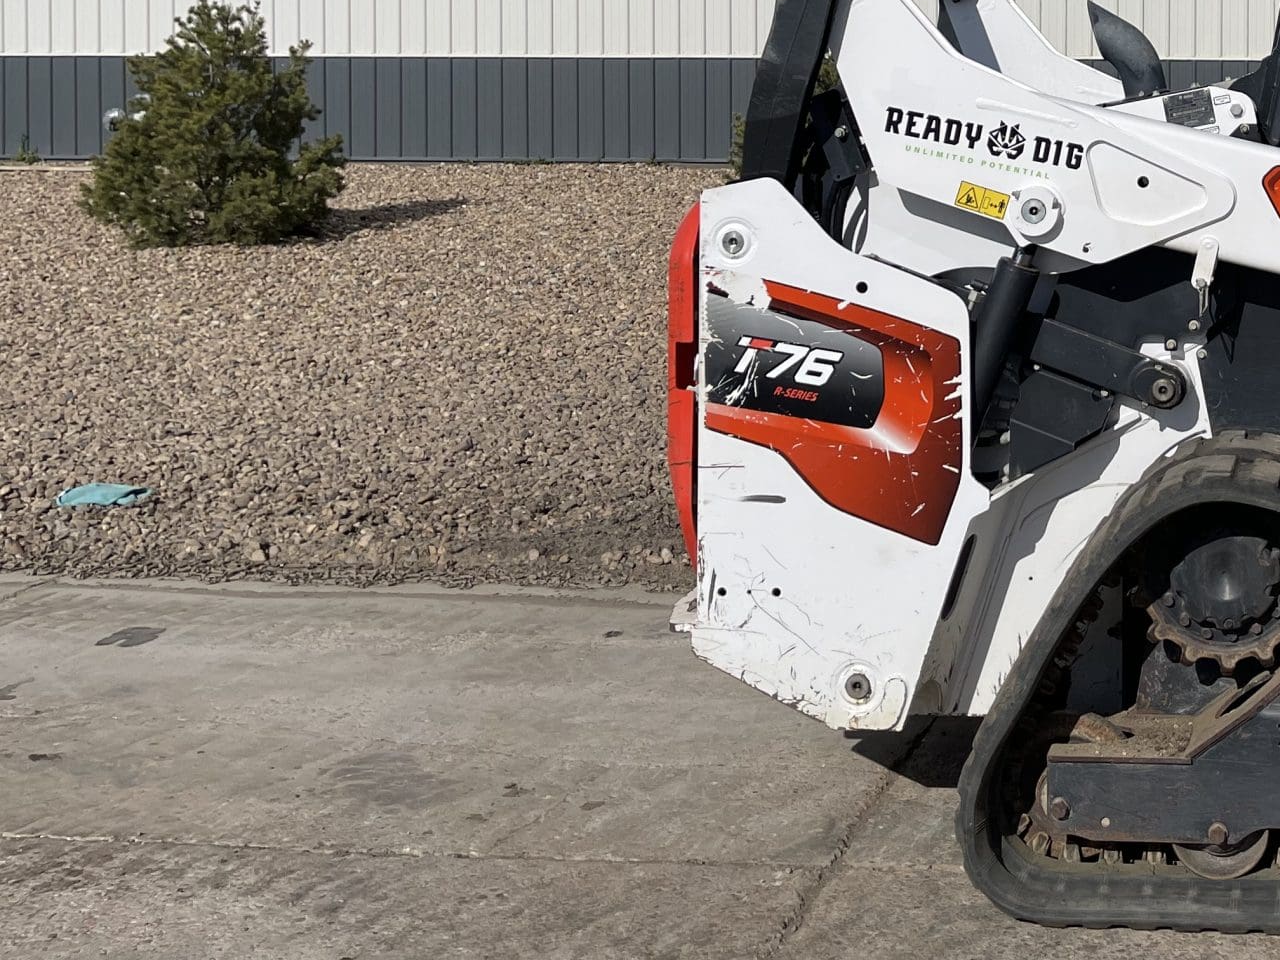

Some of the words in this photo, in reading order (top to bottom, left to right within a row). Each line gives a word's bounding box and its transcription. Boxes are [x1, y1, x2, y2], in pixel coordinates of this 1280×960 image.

[884, 106, 984, 150] READY
[1032, 135, 1085, 170] DIG
[904, 144, 974, 165] UNLIMITED
[980, 159, 1051, 180] POTENTIAL
[733, 335, 845, 387] T76
[773, 385, 820, 402] R-SERIES
